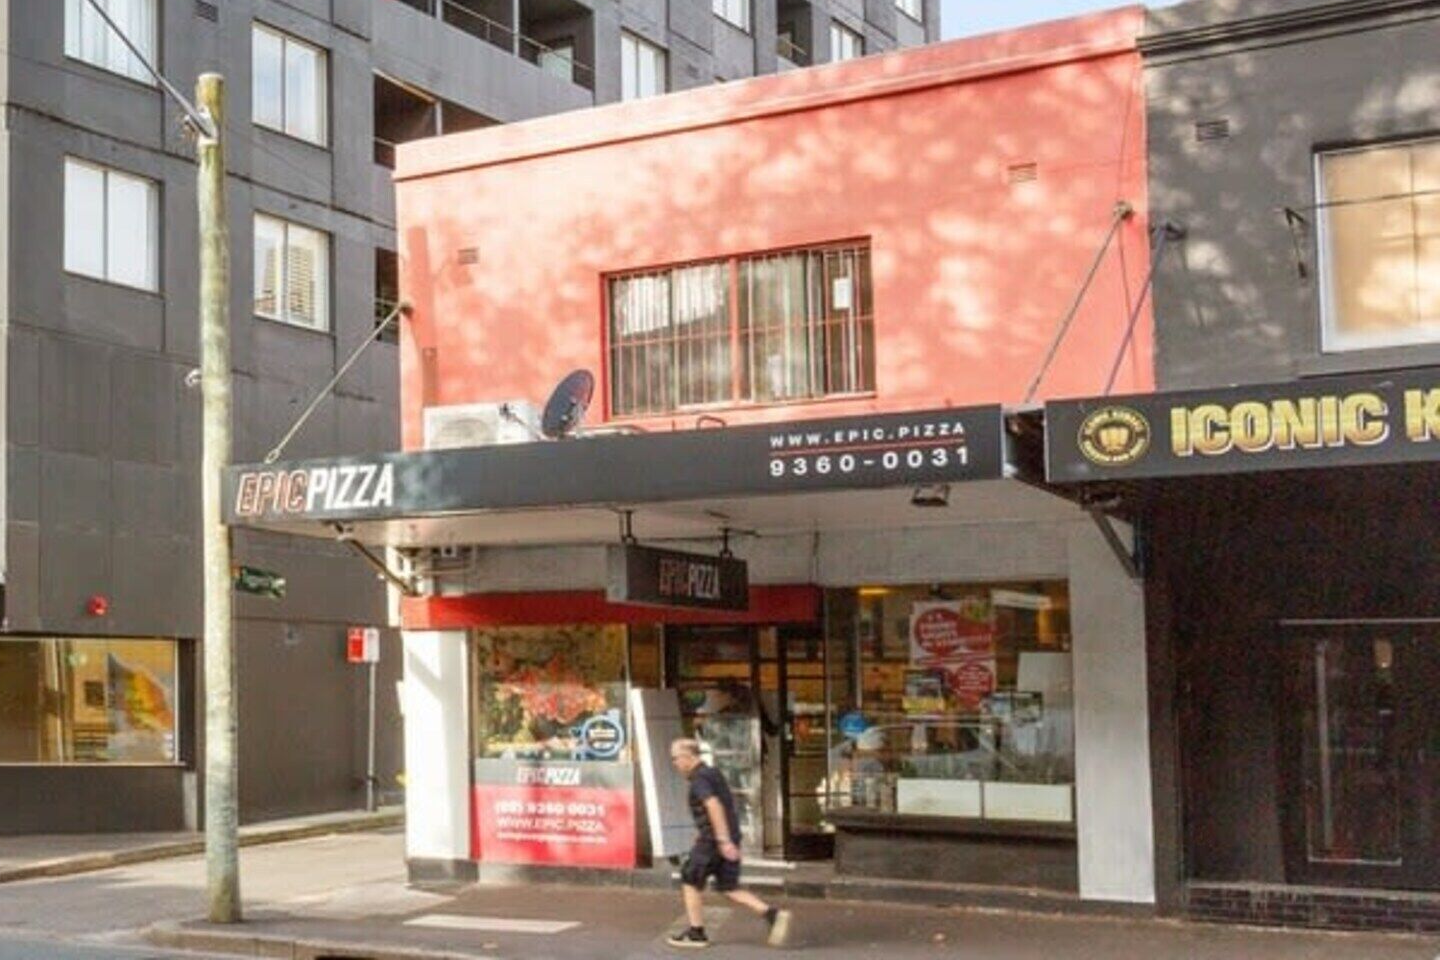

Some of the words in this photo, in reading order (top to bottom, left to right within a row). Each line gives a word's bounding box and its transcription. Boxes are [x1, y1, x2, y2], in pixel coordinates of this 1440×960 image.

[769, 422, 966, 449] WWW.EPIC.PIZZA
[1170, 392, 1390, 457] ICONIC
[769, 446, 969, 477] 9360-0031
